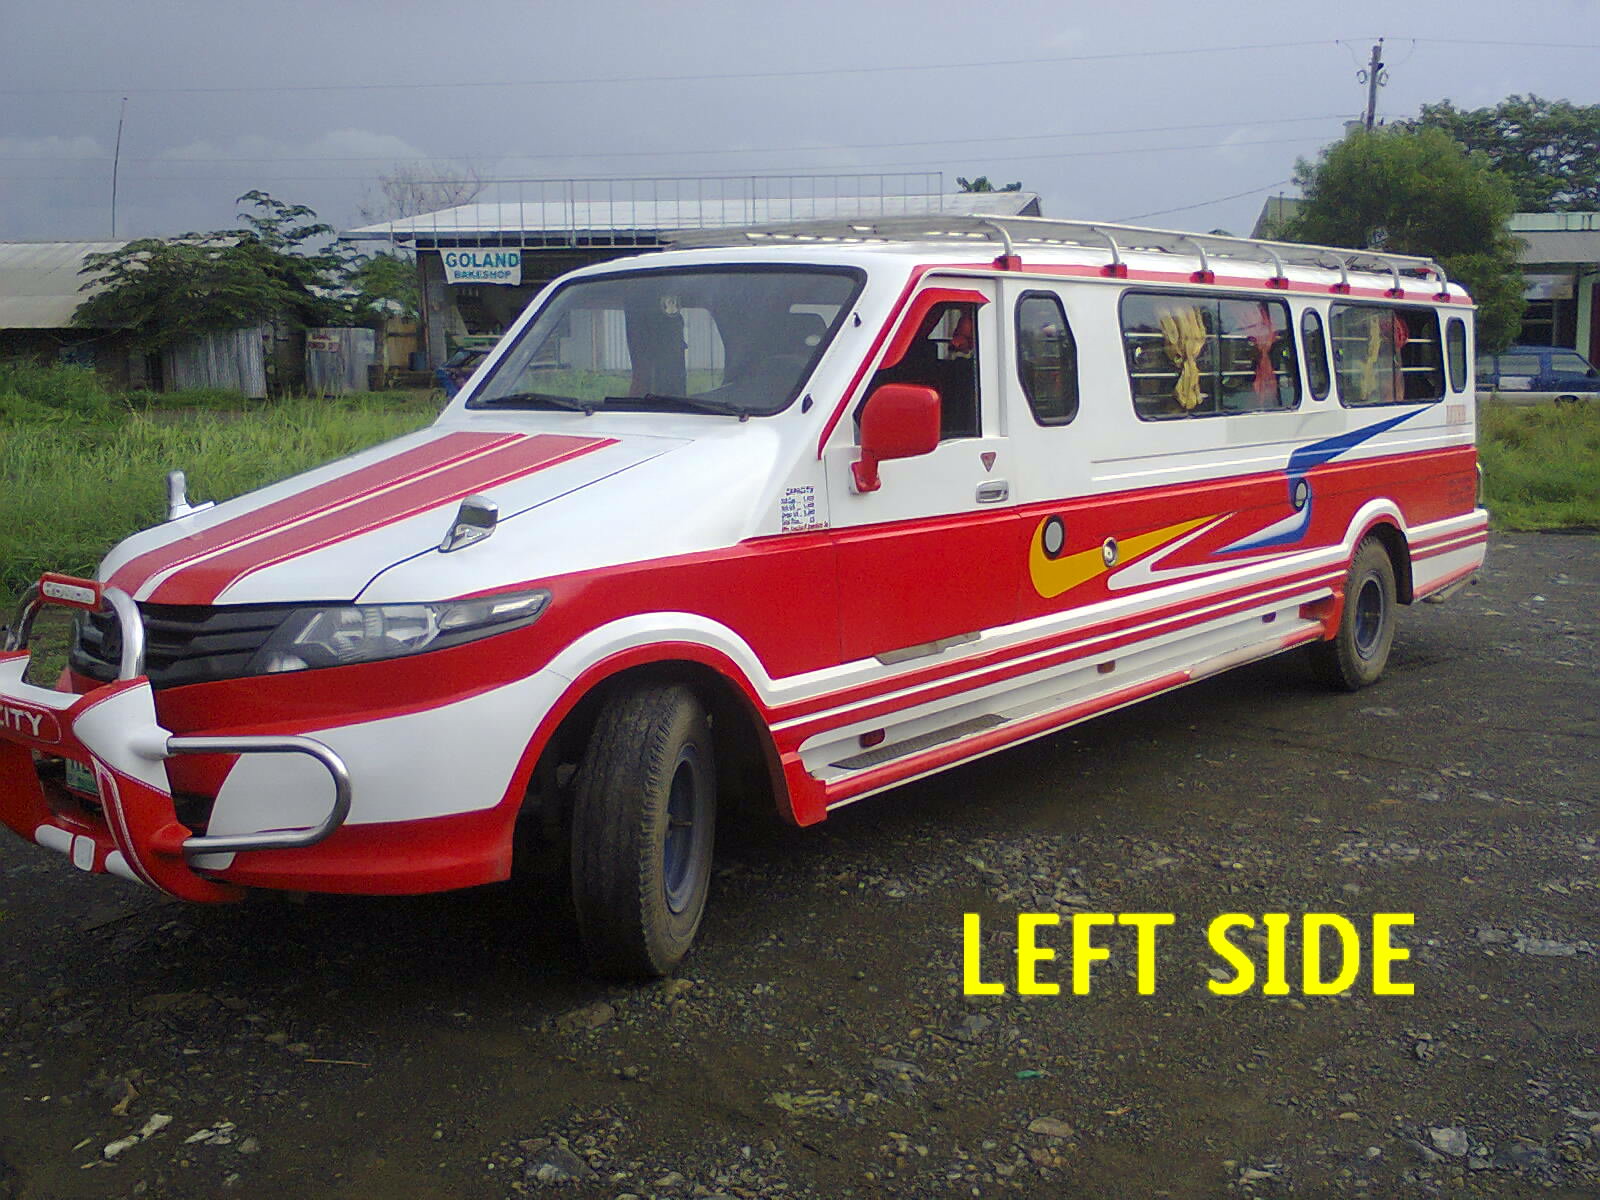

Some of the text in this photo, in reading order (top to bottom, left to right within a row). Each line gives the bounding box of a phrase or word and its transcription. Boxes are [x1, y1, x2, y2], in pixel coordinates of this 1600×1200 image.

[446, 252, 520, 268] GOLAND
[454, 270, 512, 279] BAKESHOP
[0, 704, 43, 737] ITY
